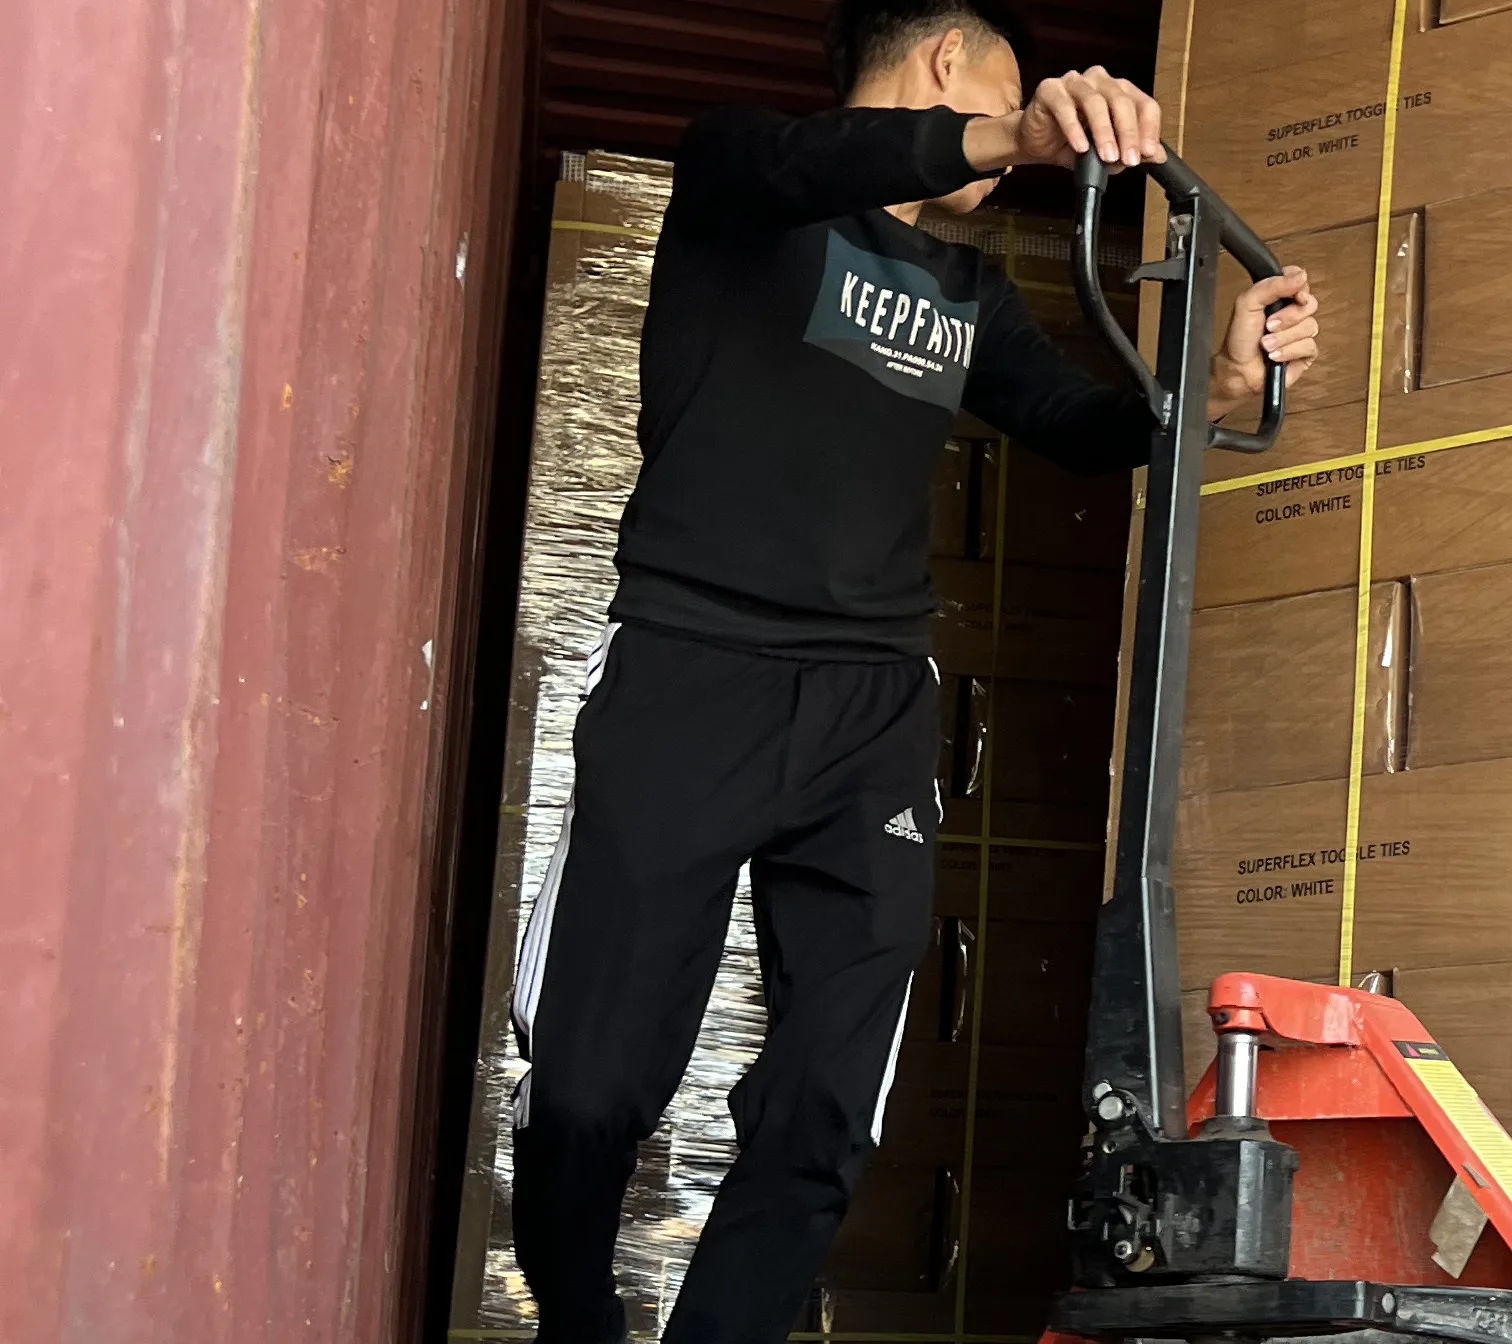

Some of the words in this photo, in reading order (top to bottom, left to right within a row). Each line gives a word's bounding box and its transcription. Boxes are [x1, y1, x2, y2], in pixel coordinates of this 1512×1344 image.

[1267, 112, 1342, 142] SUPERFLEX
[1403, 91, 1432, 110] TIES
[1318, 134, 1360, 155] WHITE
[1256, 470, 1332, 497] SUPERFLEX
[1337, 459, 1392, 482] TOGLE
[1397, 455, 1426, 472] TIES
[1309, 494, 1351, 515] WHITE
[1237, 852, 1316, 875] SUPERFLEX
[1380, 840, 1411, 857] TIES
[1291, 879, 1334, 898] WHITE
